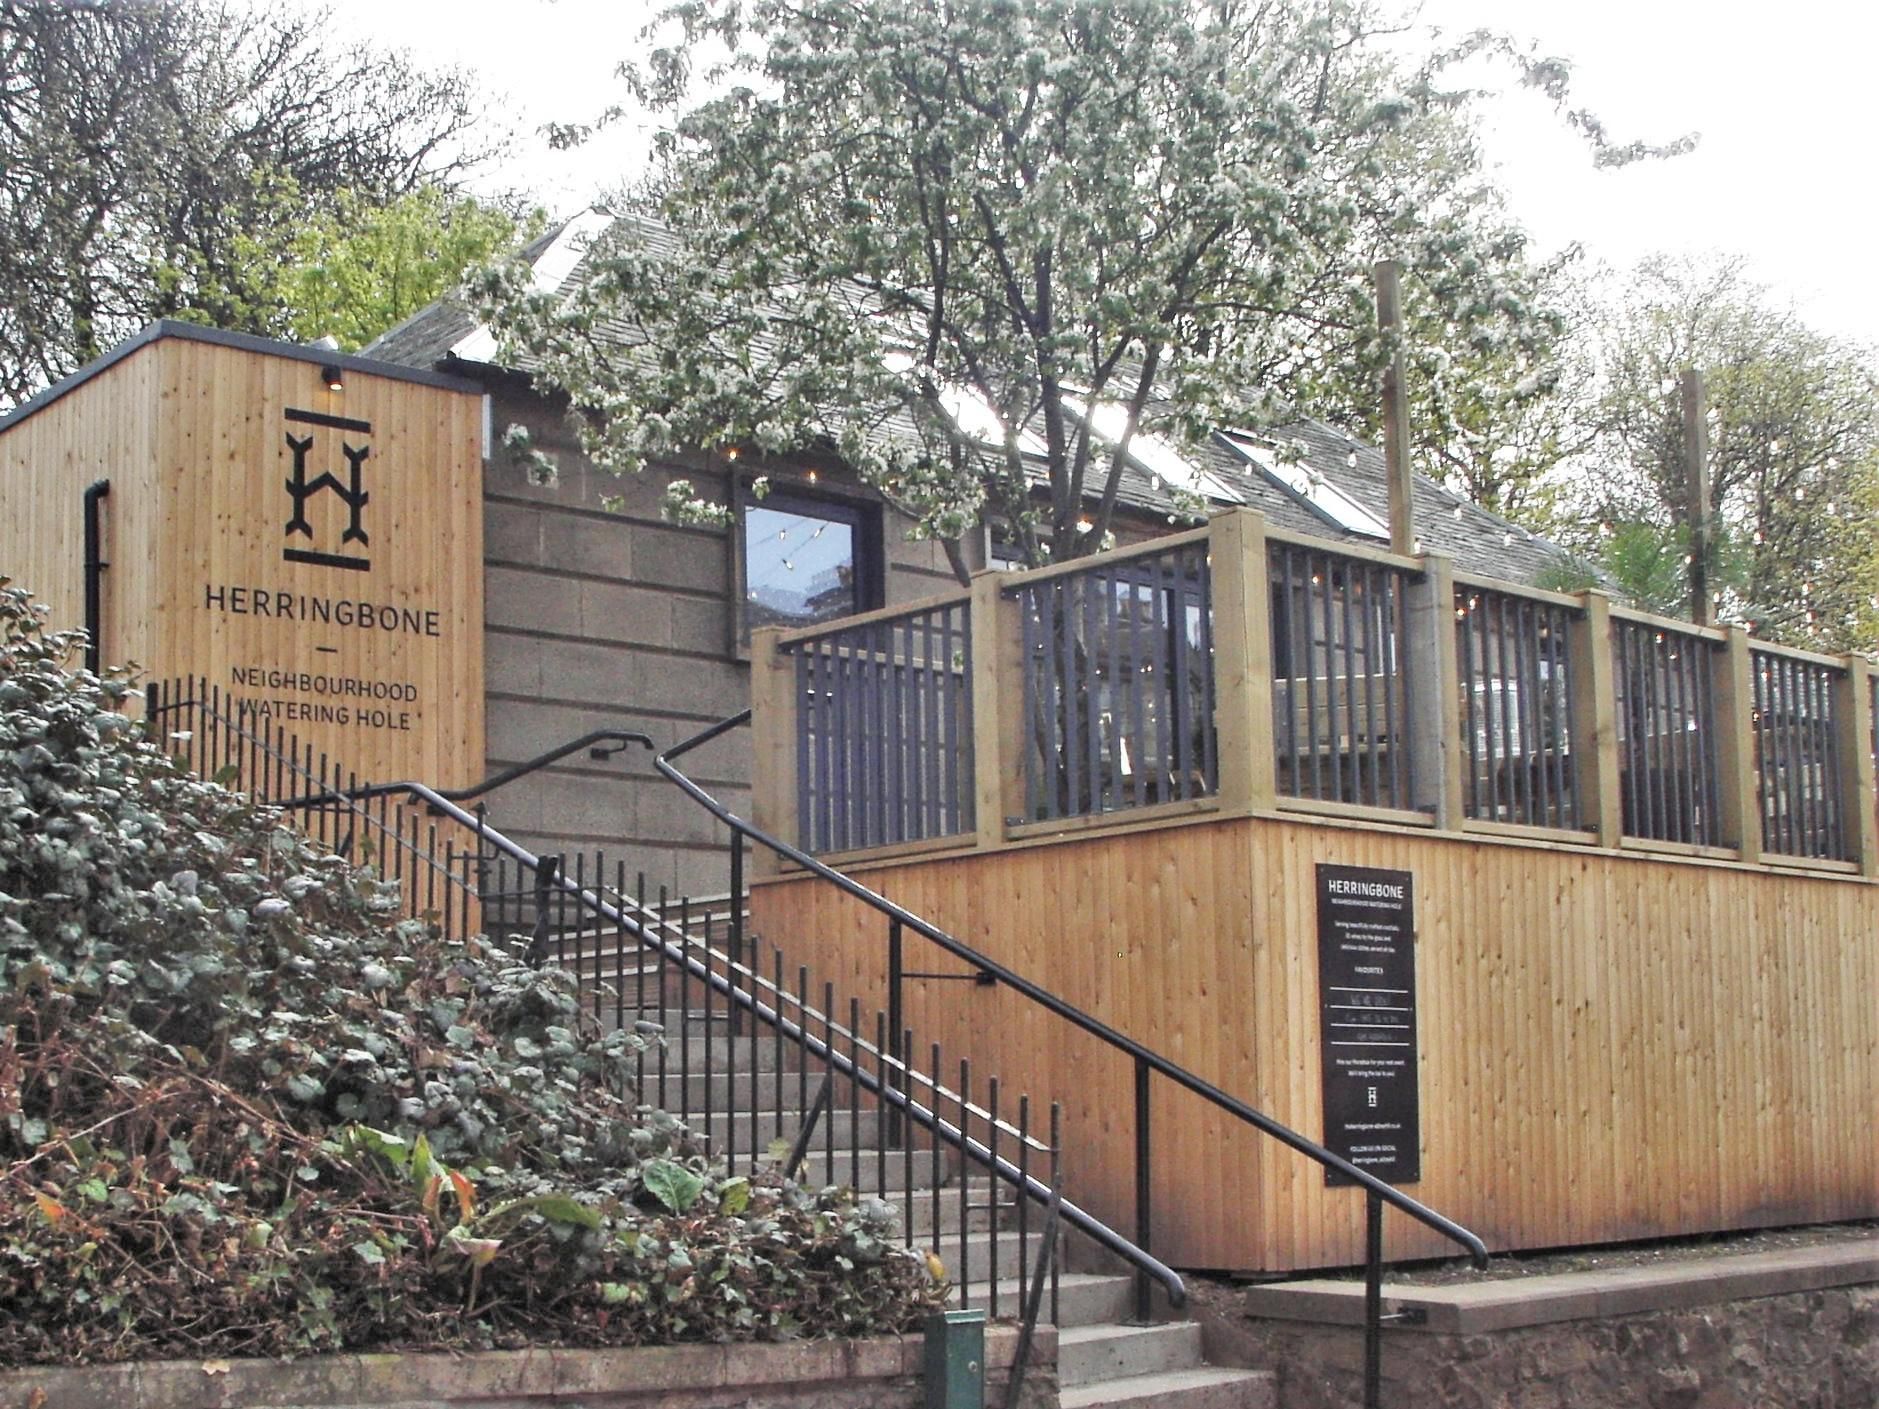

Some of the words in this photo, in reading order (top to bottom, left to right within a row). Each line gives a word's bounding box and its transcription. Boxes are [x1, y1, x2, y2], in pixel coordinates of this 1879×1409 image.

[205, 584, 440, 637] HERRINGBONE
[231, 666, 418, 702] NEIGHBOURHOOD
[239, 697, 350, 725] WATERING
[356, 708, 411, 730] HOLE
[1328, 879, 1404, 899] HERRINGBONE
